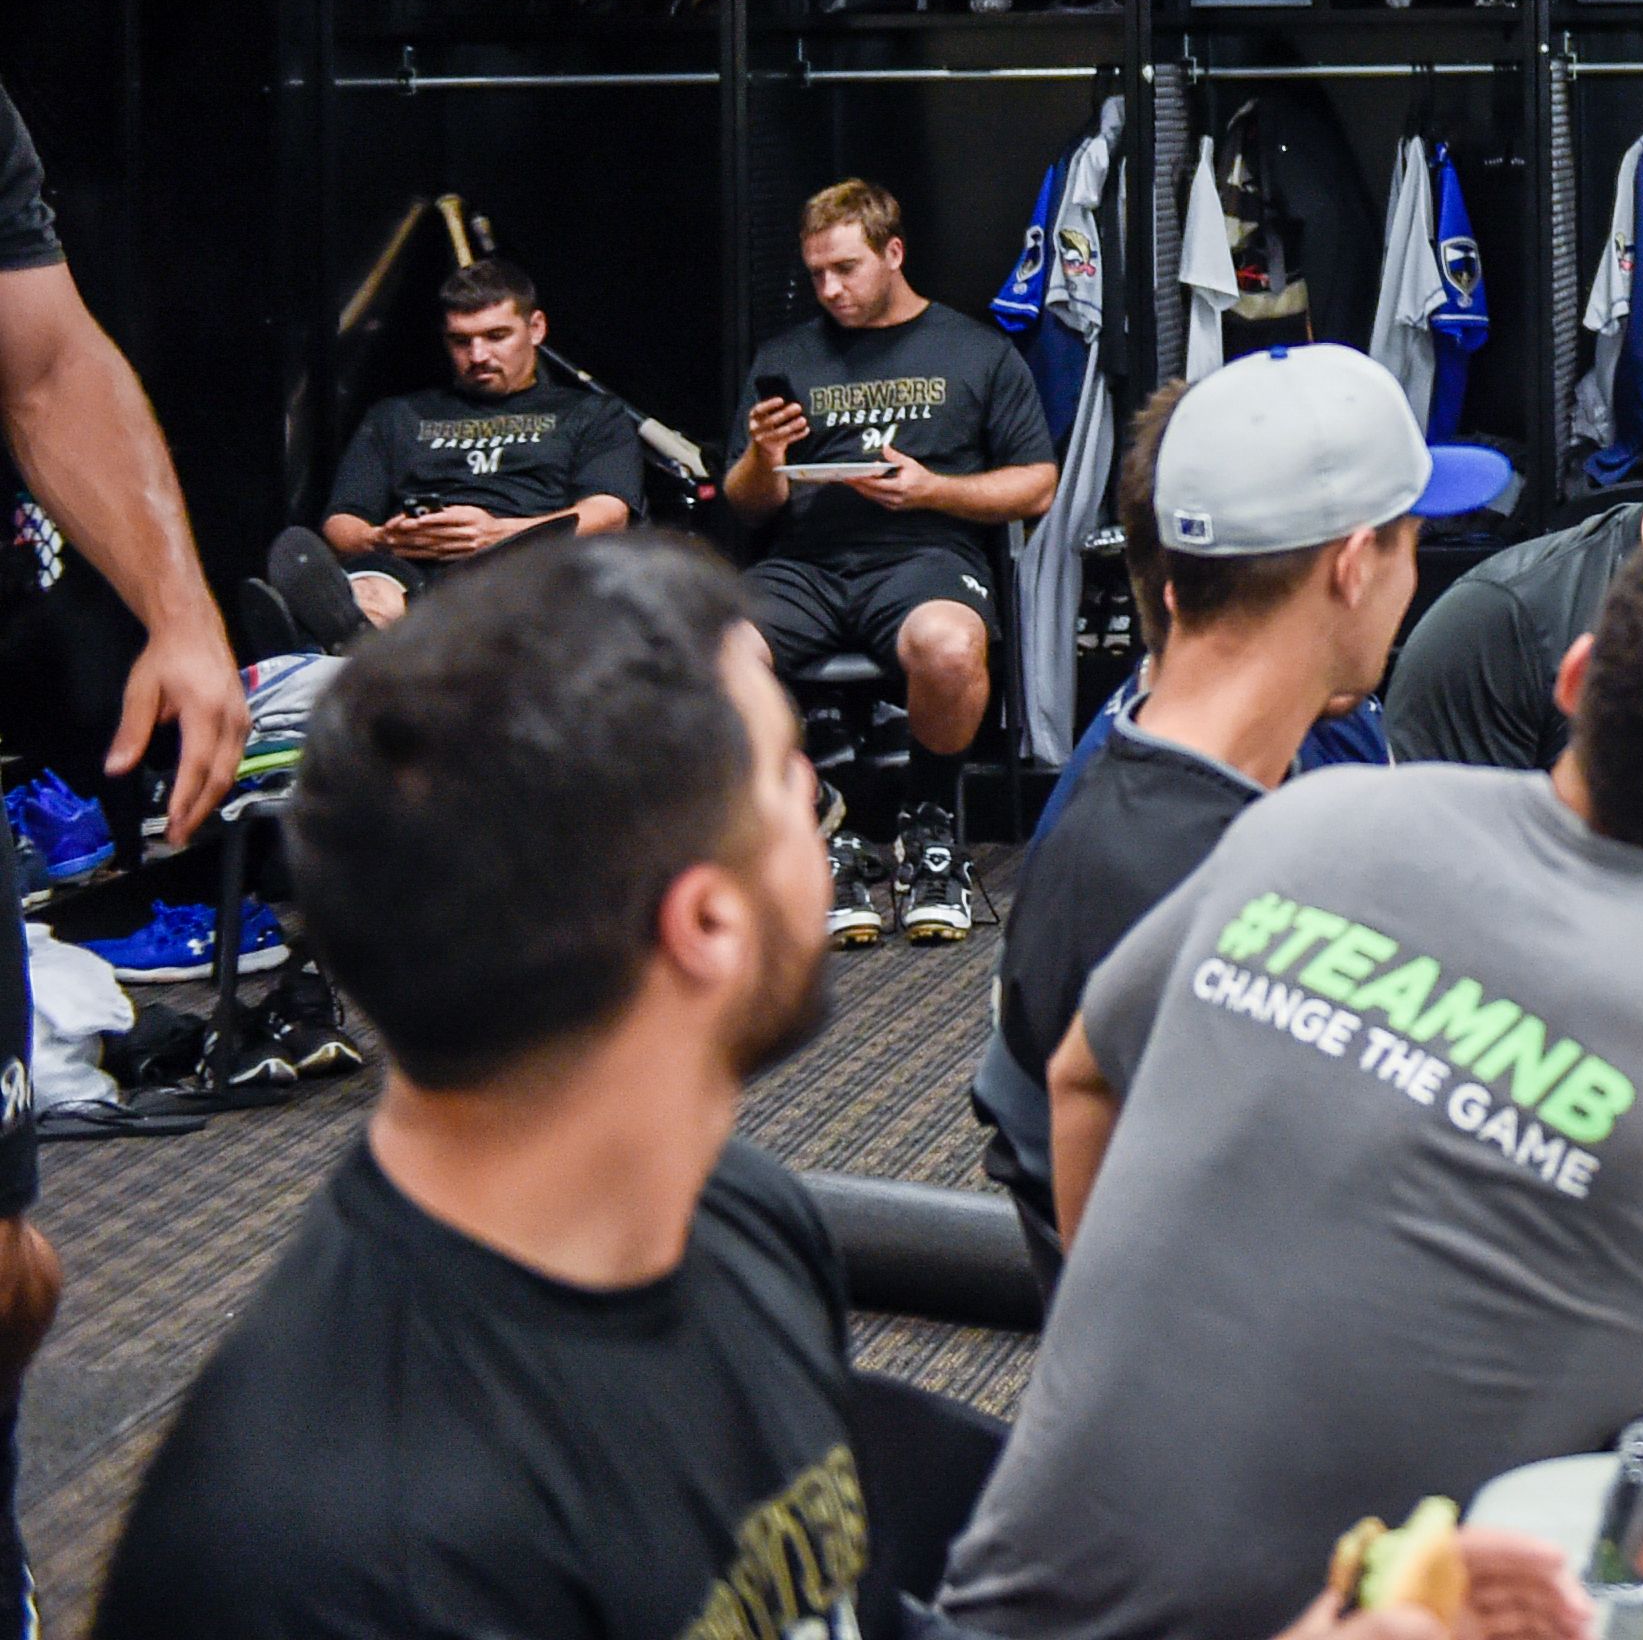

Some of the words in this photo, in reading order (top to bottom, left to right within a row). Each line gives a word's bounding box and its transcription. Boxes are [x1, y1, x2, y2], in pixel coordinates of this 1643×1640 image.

[809, 376, 947, 416] BREWERS
[825, 404, 932, 428] BASEBALL
[1192, 956, 1362, 1058] CHANGE
[1359, 1025, 1452, 1107] THE
[1447, 1080, 1601, 1199] GAME
[1216, 890, 1637, 1144] #TEAMNB
